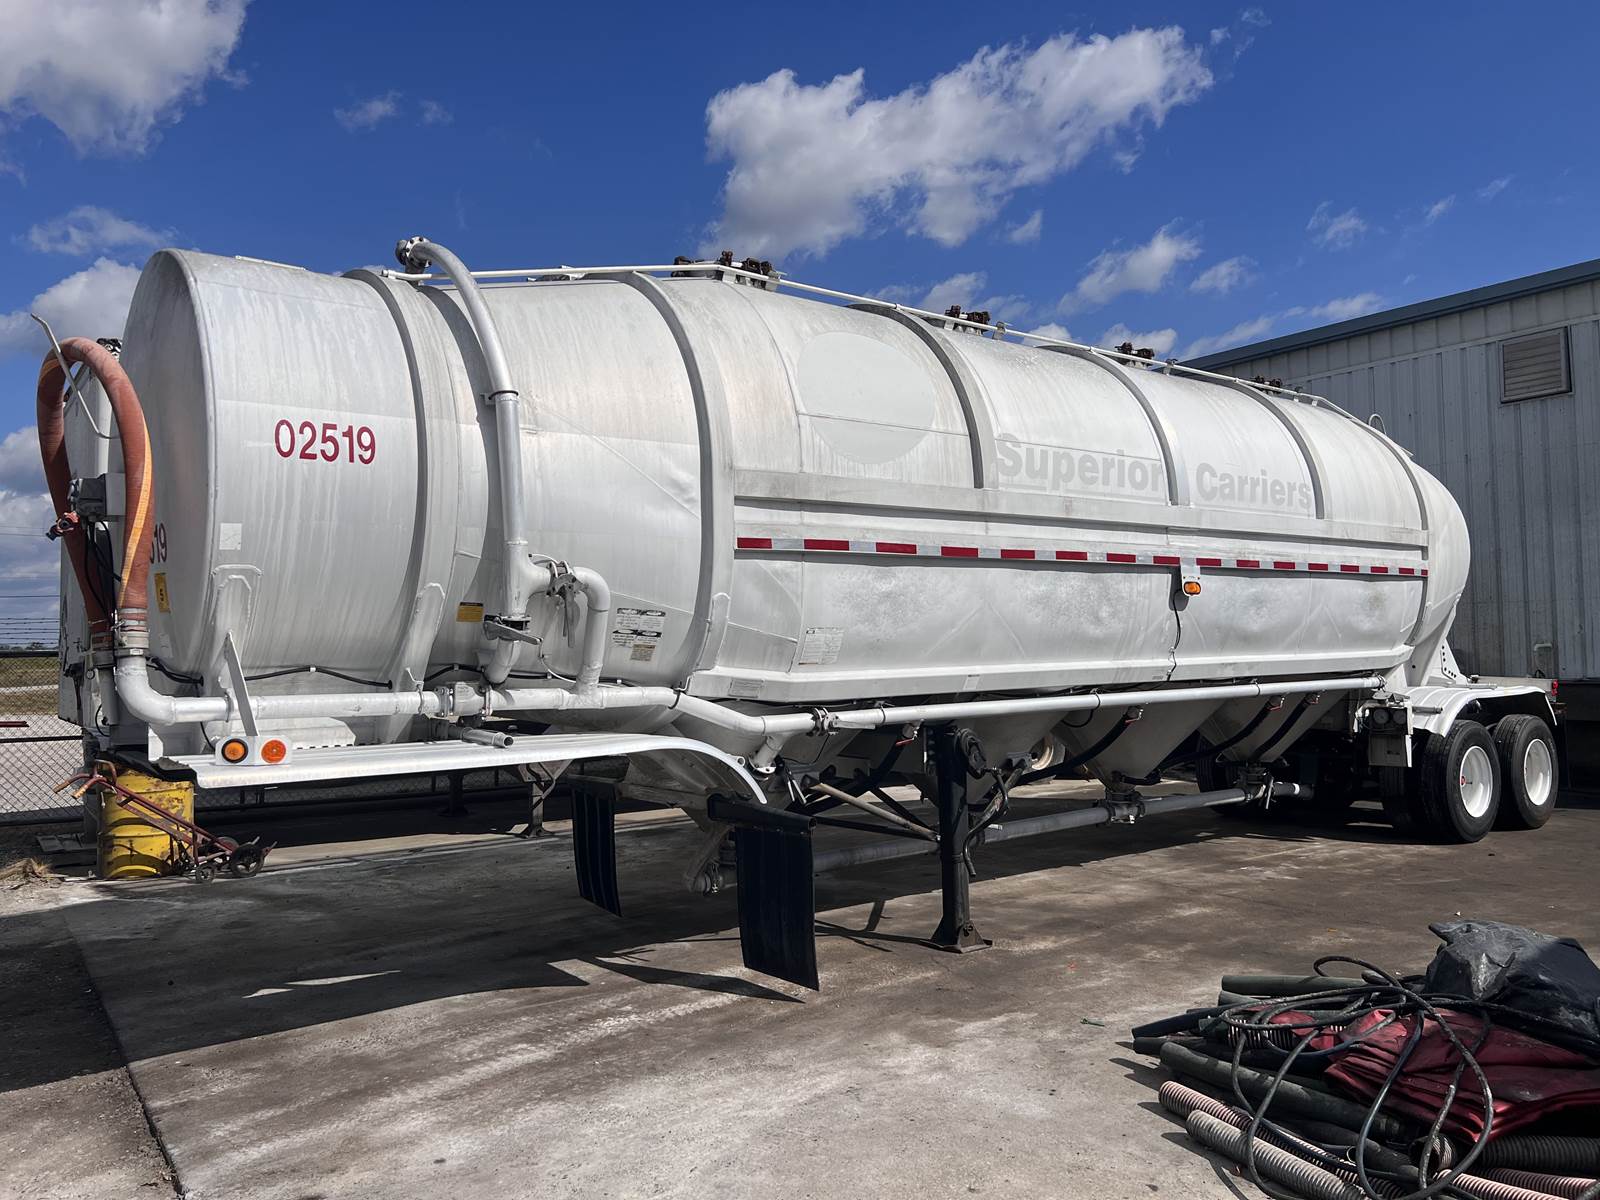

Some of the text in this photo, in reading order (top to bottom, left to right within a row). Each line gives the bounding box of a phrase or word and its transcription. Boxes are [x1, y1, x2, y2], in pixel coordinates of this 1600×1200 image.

[274, 419, 376, 464] 02519
[994, 433, 1312, 510] Superior Carriers
